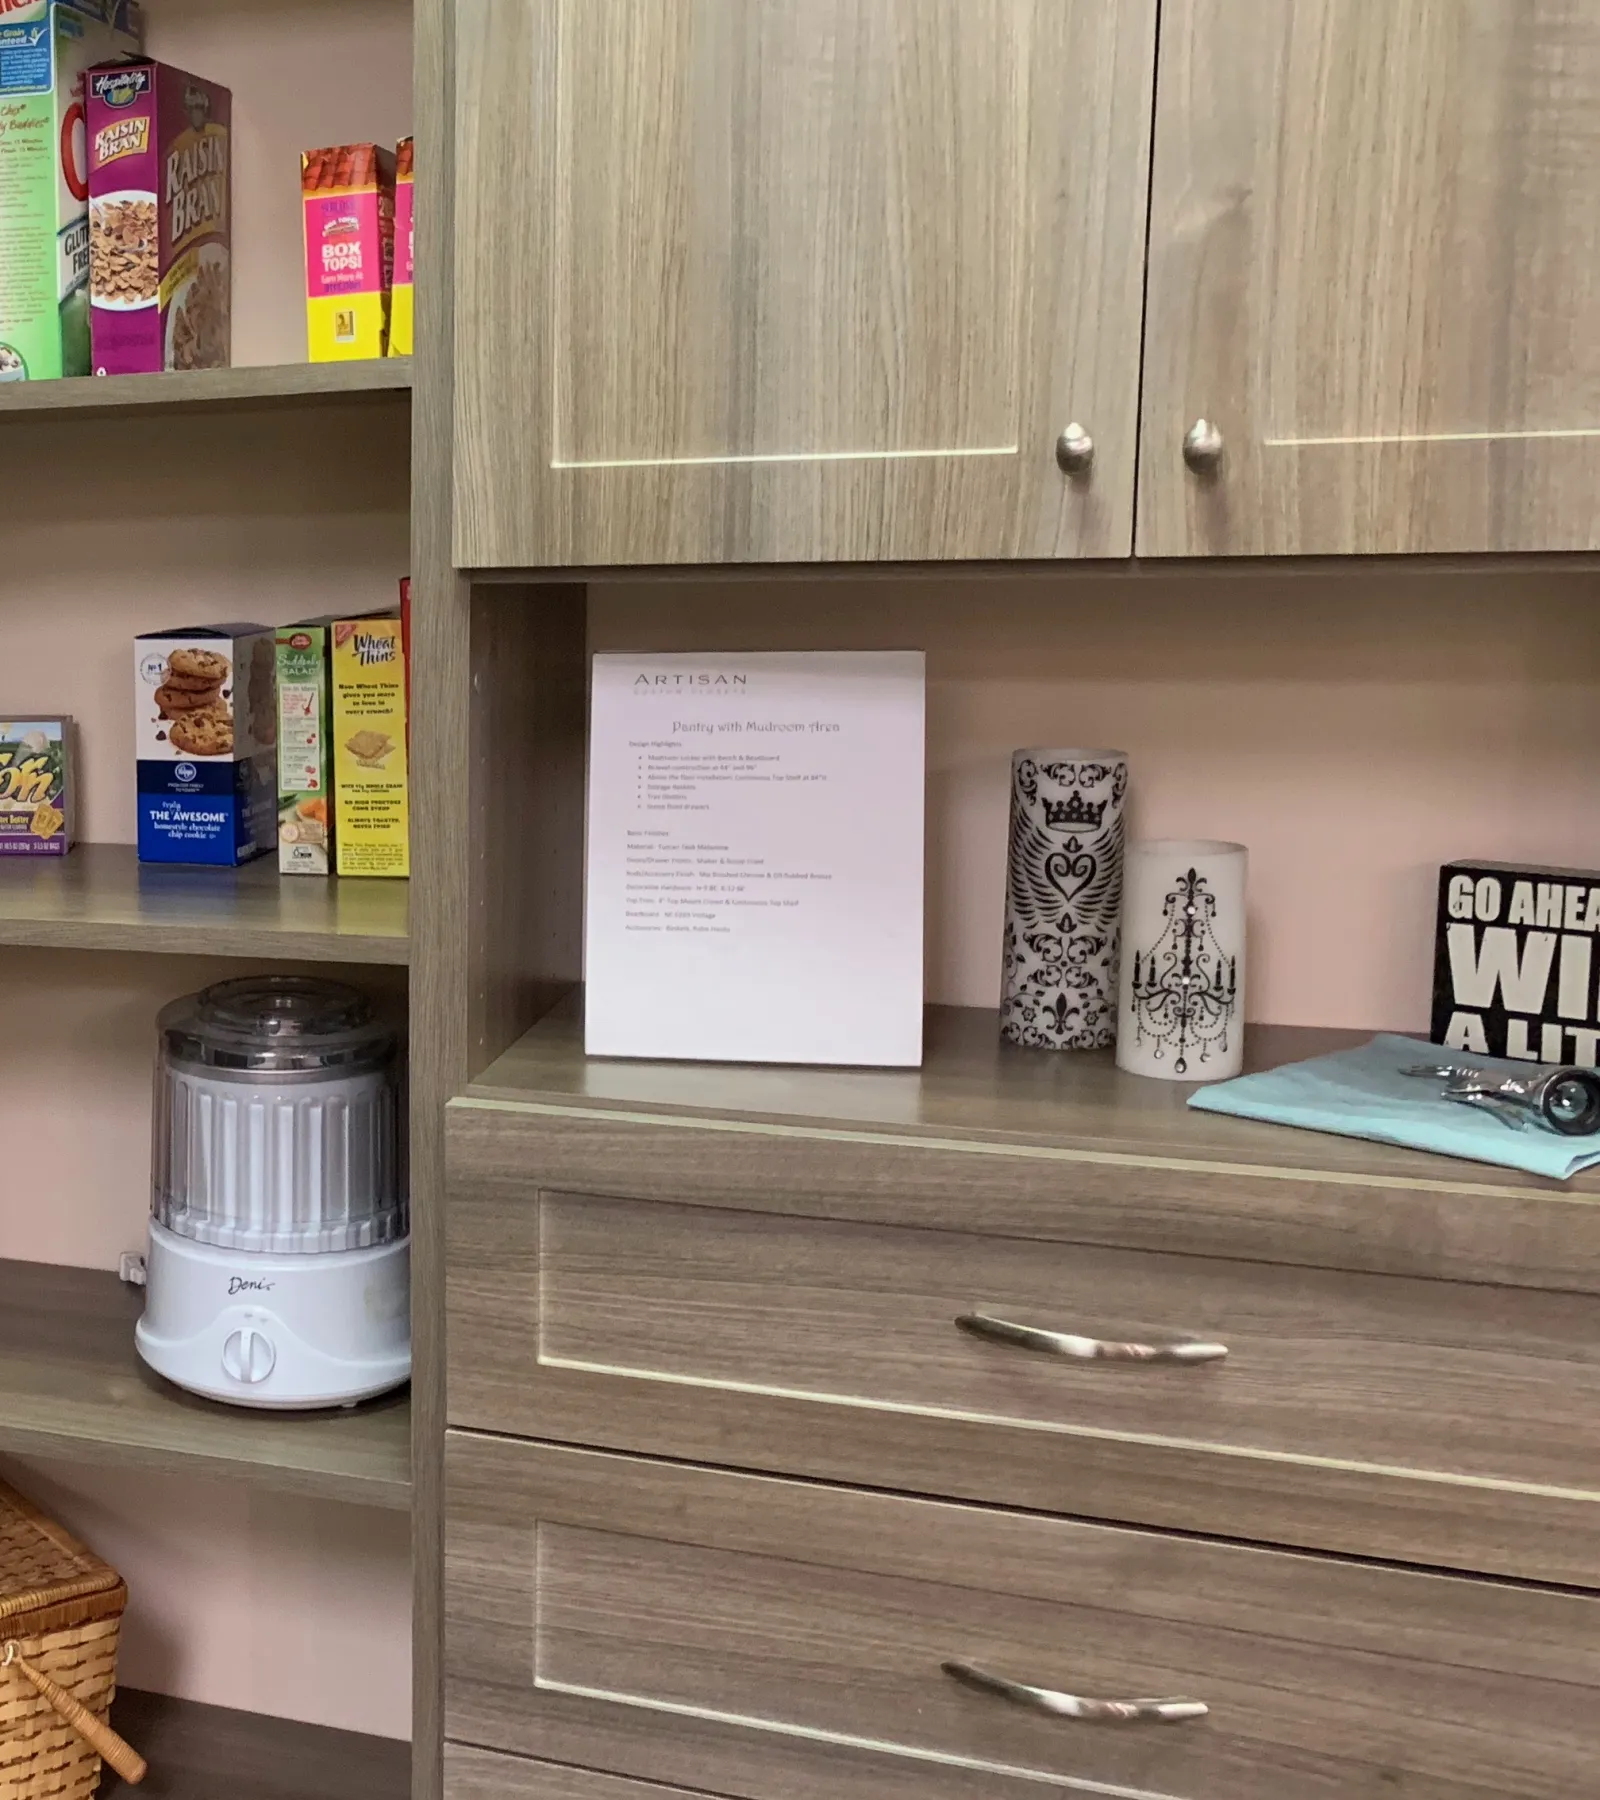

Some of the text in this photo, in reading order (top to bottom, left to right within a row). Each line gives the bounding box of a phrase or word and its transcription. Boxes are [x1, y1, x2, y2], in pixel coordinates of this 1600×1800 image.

[95, 71, 146, 93] Hospitality
[94, 118, 146, 150] RAISIN
[100, 133, 142, 162] BRAN
[167, 133, 228, 203] RAISIN
[172, 179, 222, 245] BRAN
[65, 226, 89, 256] GLUT
[322, 242, 361, 258] BOX
[72, 252, 89, 276] FRE
[323, 255, 362, 272] TOPS!
[353, 632, 396, 650] Wheat
[352, 650, 396, 667] Thins
[282, 667, 314, 675] SALAD
[634, 674, 747, 685] ARTISAN
[672, 721, 840, 734] Pantry with Mudroom Area
[10, 815, 29, 824] Butter
[150, 811, 170, 821] THE
[154, 820, 221, 832] homestyle chocolate
[168, 831, 183, 840] chip
[1448, 875, 1600, 932] GO AHEA
[1446, 922, 1600, 1022] WI
[1443, 1011, 1600, 1068] A LIT
